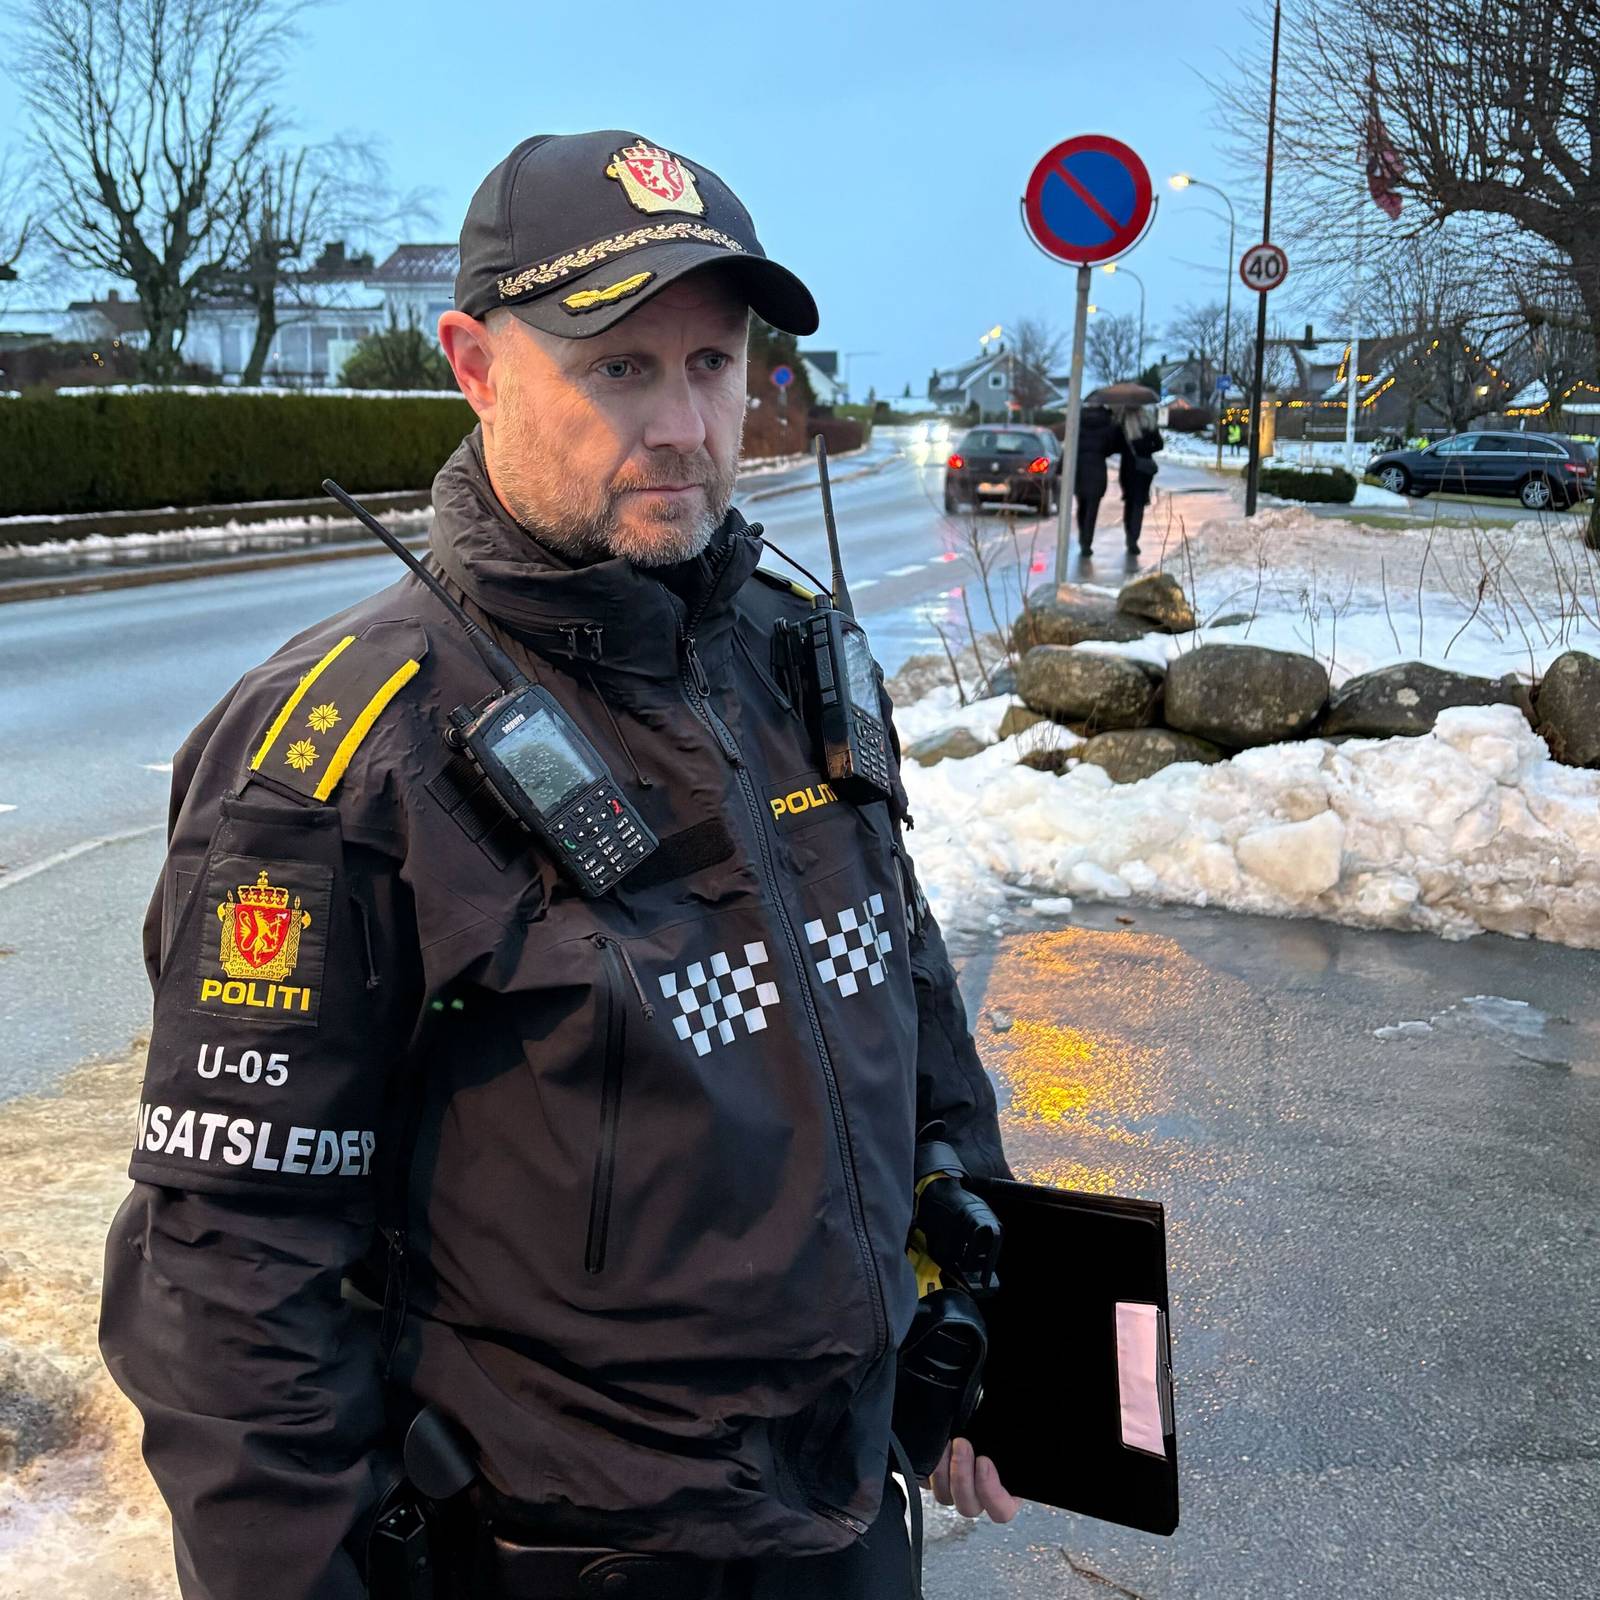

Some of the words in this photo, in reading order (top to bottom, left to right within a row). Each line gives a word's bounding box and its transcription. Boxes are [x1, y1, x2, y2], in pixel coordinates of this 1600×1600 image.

[1247, 255, 1280, 280] 40
[201, 979, 311, 1011] POLITI
[197, 1044, 289, 1086] U-05
[134, 1103, 376, 1175] NSATSLEDER
